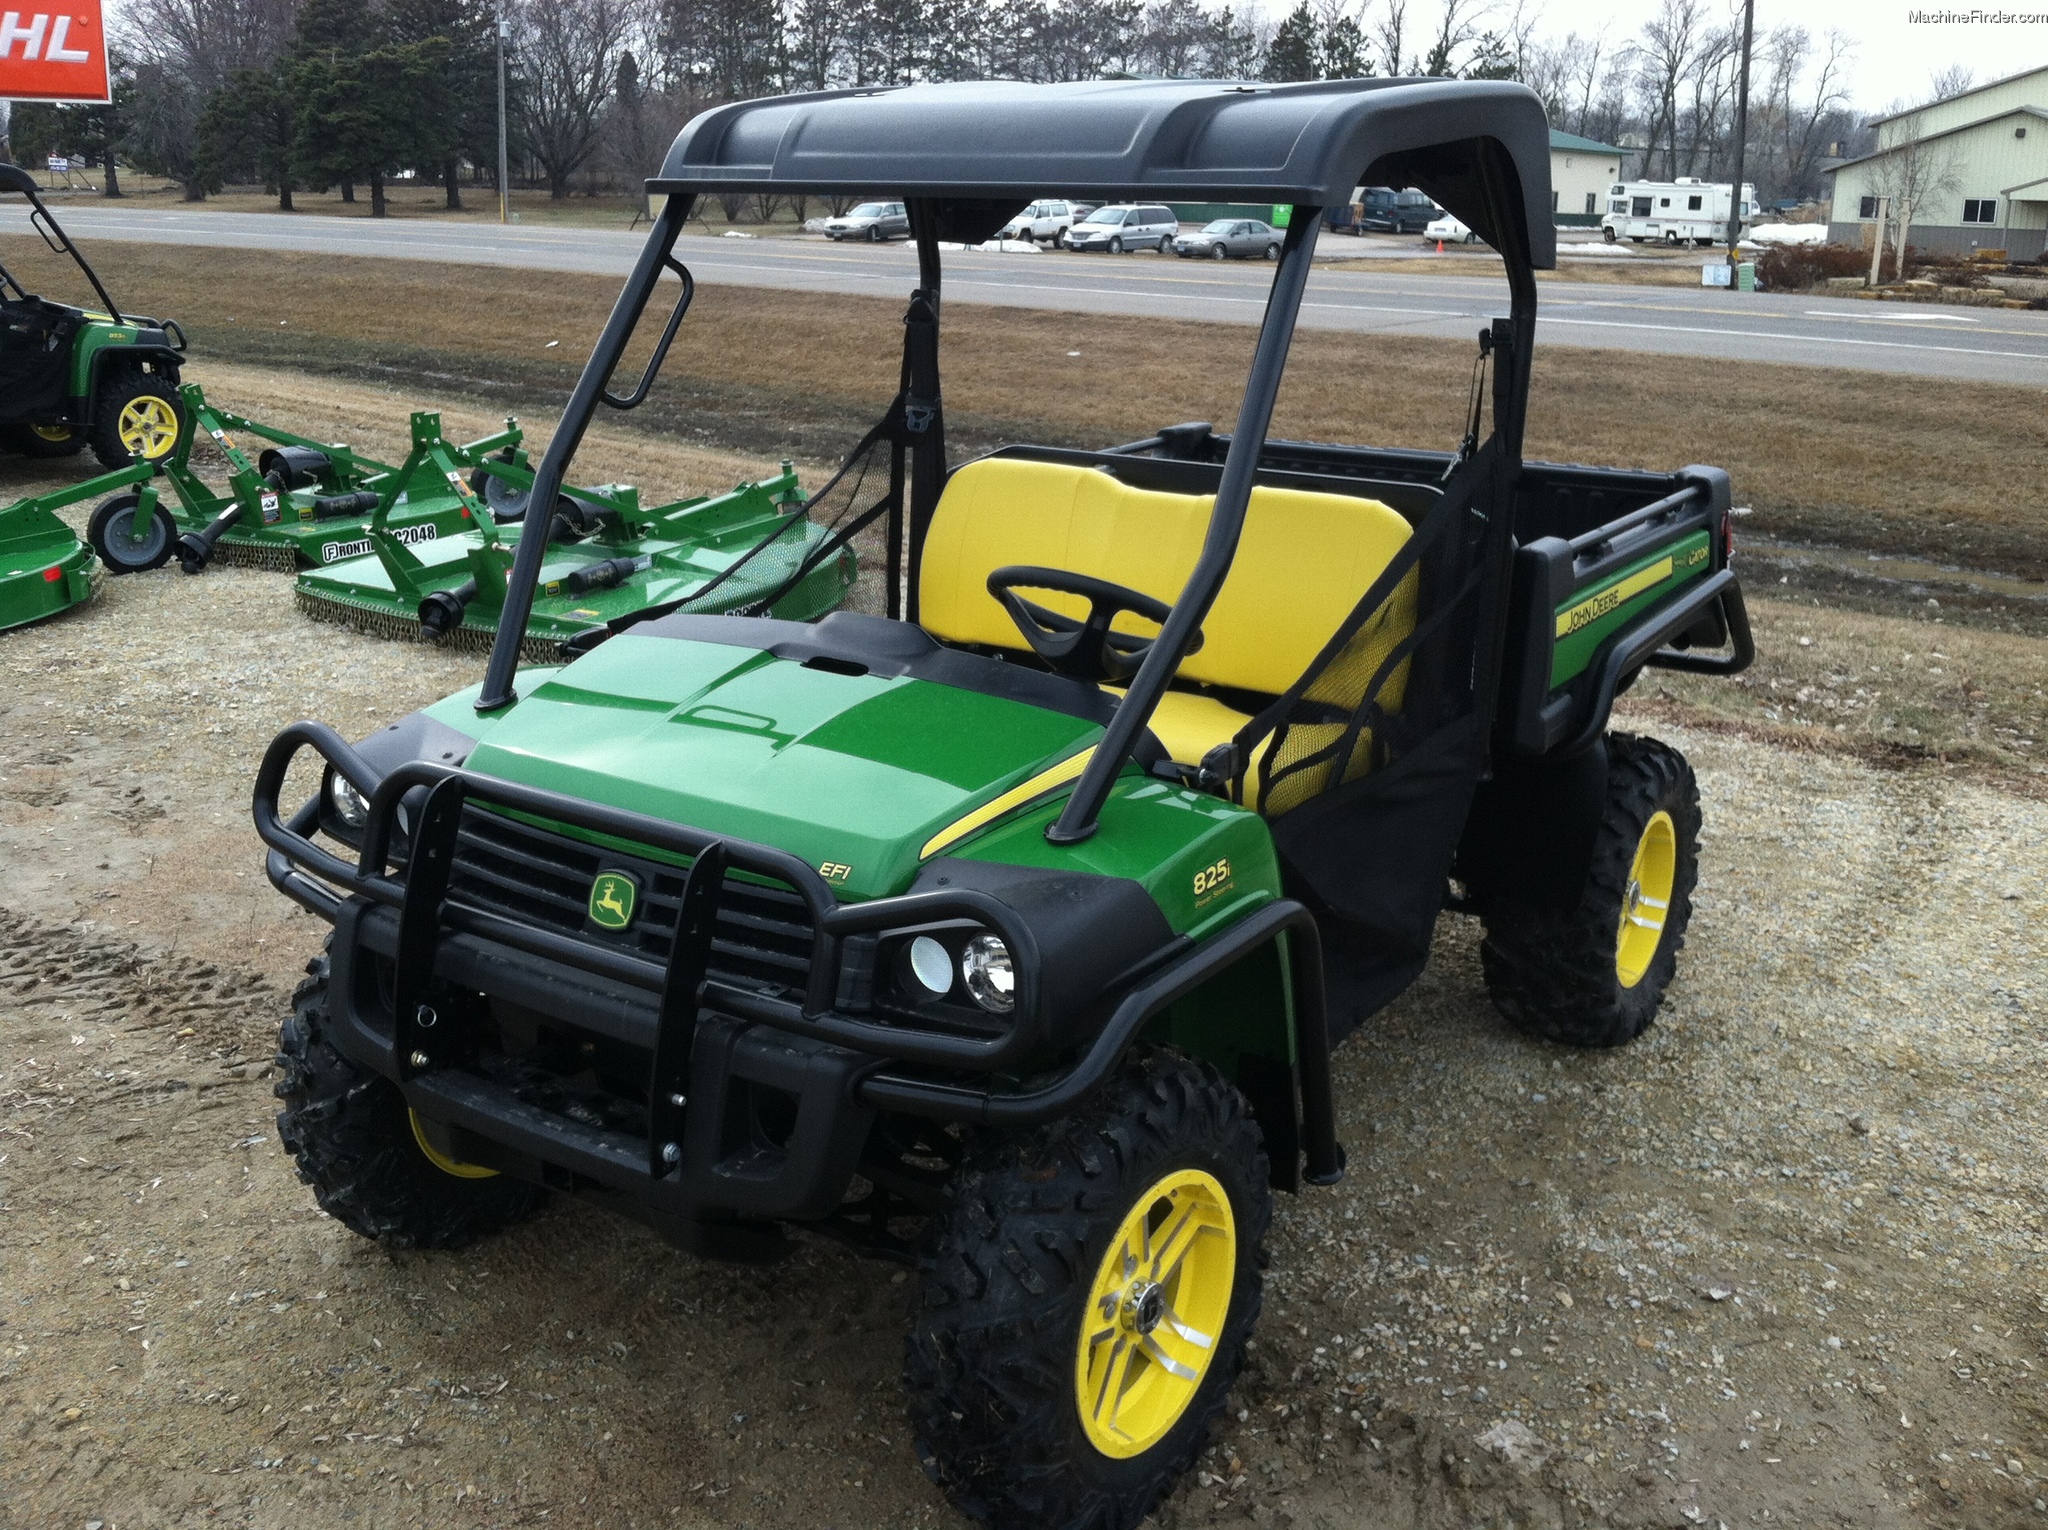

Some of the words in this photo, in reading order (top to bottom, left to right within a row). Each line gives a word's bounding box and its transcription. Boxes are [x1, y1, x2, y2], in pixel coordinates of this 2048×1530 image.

[0, 11, 90, 64] HL
[1567, 605, 1591, 632] JOHN
[1592, 589, 1619, 618] DEERE
[818, 861, 852, 880] EFI
[1193, 858, 1231, 895] 825i
